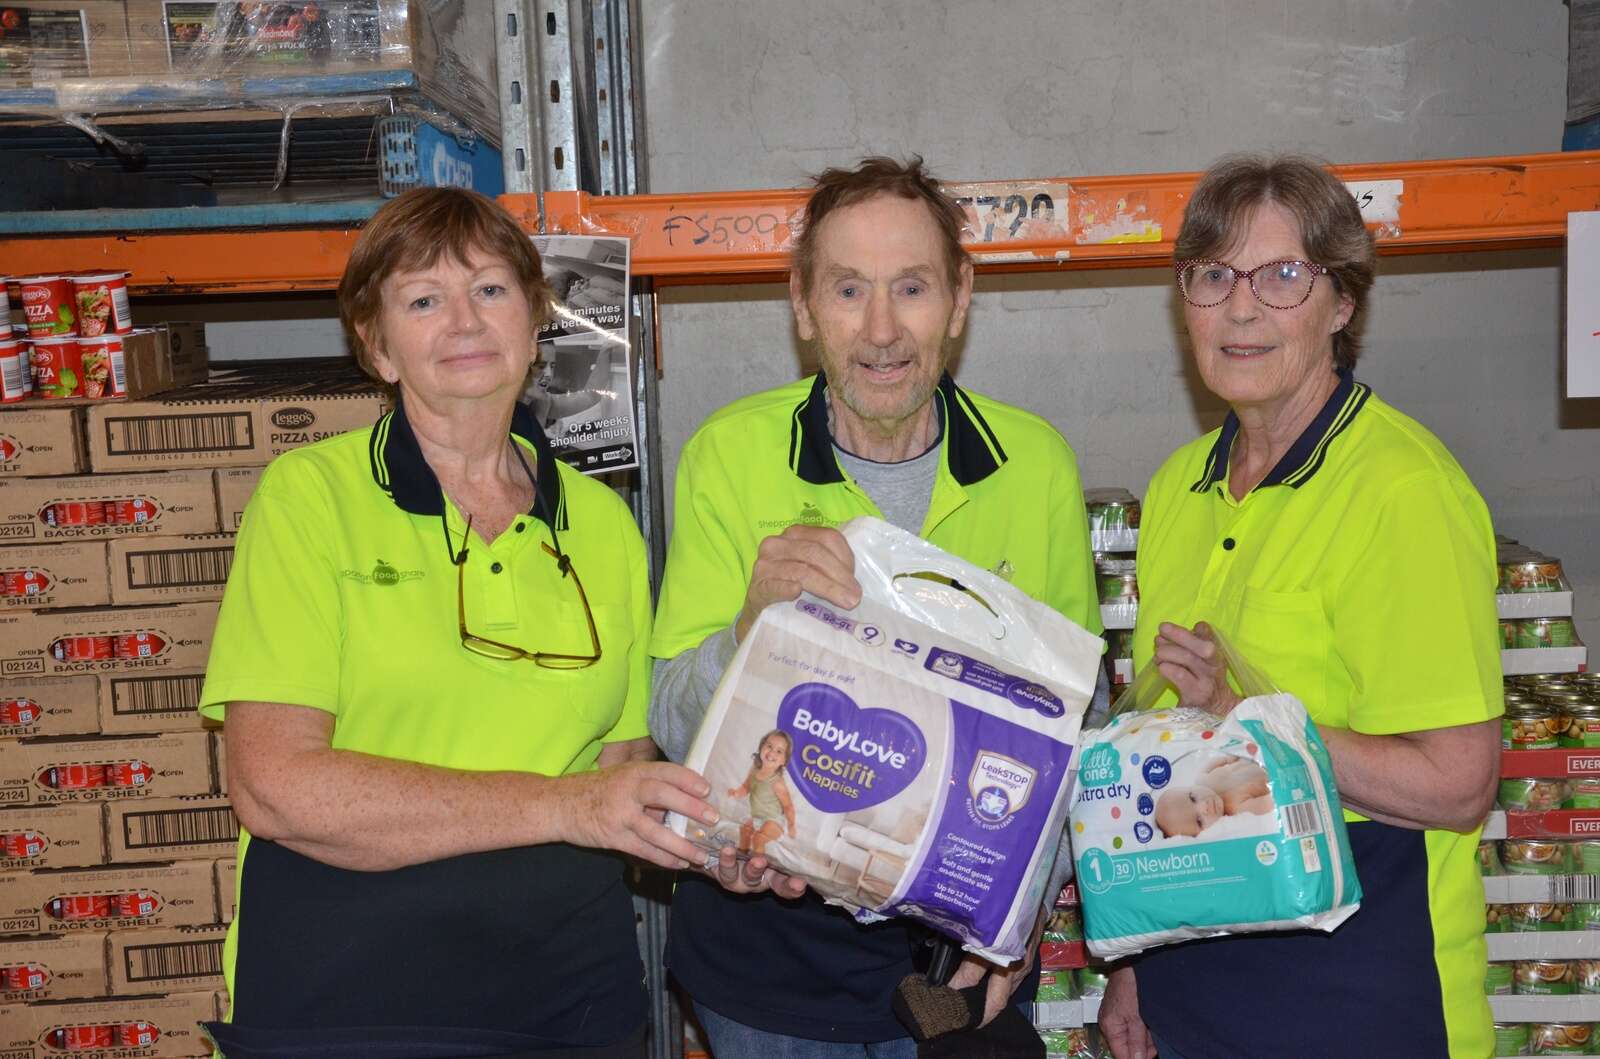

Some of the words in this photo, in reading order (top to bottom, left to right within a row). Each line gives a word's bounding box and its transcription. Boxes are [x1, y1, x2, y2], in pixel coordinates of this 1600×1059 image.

[574, 304, 621, 316] minutes
[598, 314, 623, 324] way.
[569, 422, 584, 434] Or
[584, 421, 592, 430] 5
[593, 415, 629, 429] weeks
[270, 432, 310, 444] PIZZA
[550, 429, 598, 448] shoulder
[600, 426, 632, 442] injury.
[44, 529, 86, 538] BACK
[90, 528, 113, 536] OF
[120, 524, 162, 534] SHELF
[7, 597, 56, 606] SHELF
[6, 661, 40, 672] 02124
[54, 664, 96, 672] BACK
[100, 662, 122, 670] OF
[125, 658, 172, 668] SHELF
[0, 726, 41, 736] HELF
[792, 708, 906, 769] BabyLove
[801, 744, 876, 789] Cosifit
[982, 762, 1028, 784] LeakSTOP
[1084, 766, 1114, 782] one's
[4, 778, 22, 786] OPEN
[802, 766, 860, 800] Nappies
[38, 792, 79, 802] BACK
[83, 792, 104, 800] OF
[106, 789, 152, 798] SHELF
[1108, 783, 1131, 800] dry
[947, 832, 984, 852] Contoured
[983, 848, 1006, 861] design
[2, 858, 48, 868] SHELF
[1090, 856, 1102, 882] 1
[1116, 864, 1130, 875] 30
[1136, 852, 1210, 874] Newborn
[948, 868, 976, 886] delicate
[976, 882, 990, 891] skin
[956, 865, 971, 874] and
[972, 870, 993, 882] gentle
[937, 882, 946, 894] Up
[956, 890, 963, 898] 12
[964, 893, 980, 904] hour
[3, 919, 36, 930] 02124
[48, 922, 88, 931] BACK
[94, 920, 115, 928] OF
[118, 918, 162, 926] SHELF
[4, 990, 52, 1000] SHELF
[113, 1050, 160, 1058] SHELF
